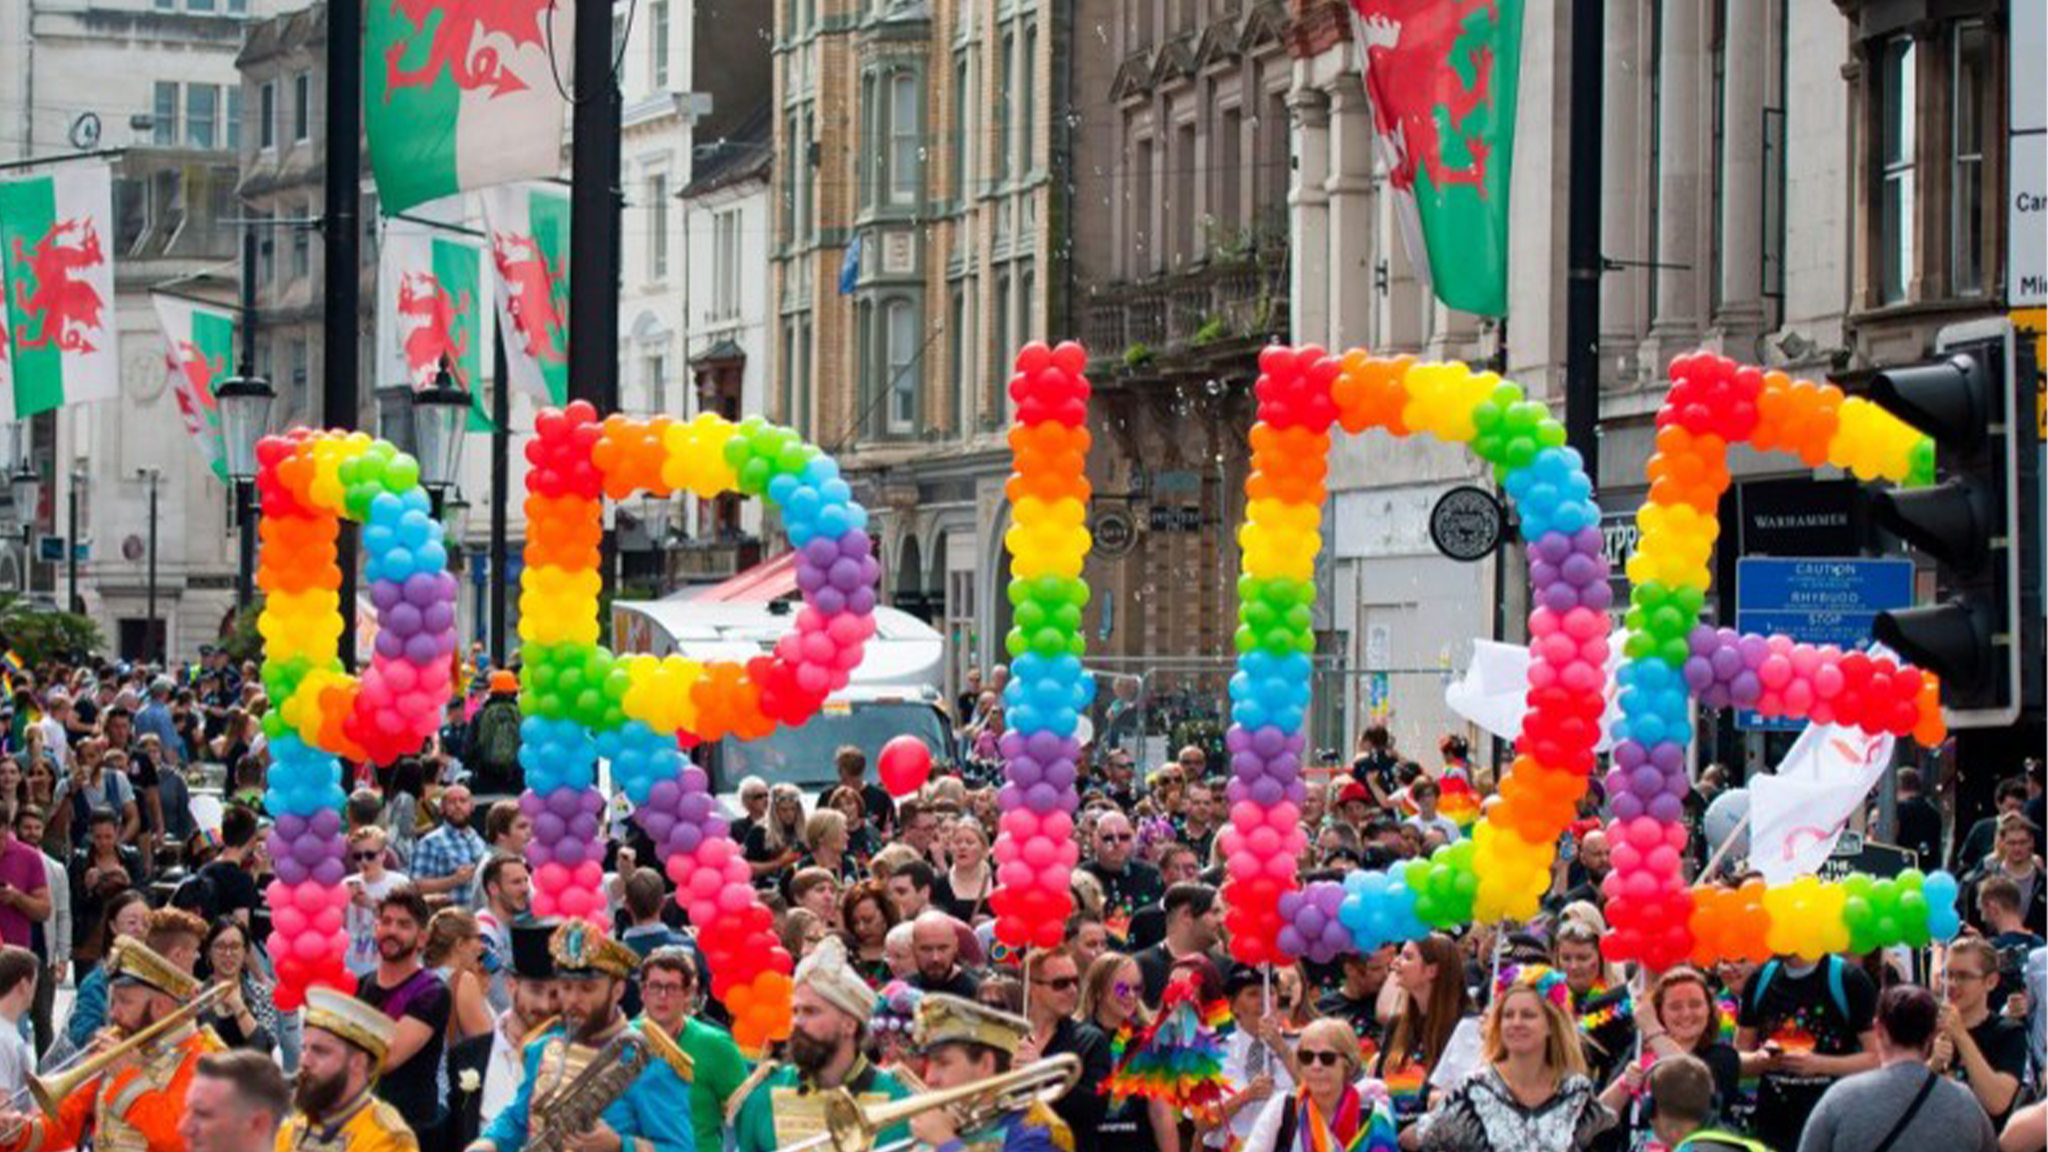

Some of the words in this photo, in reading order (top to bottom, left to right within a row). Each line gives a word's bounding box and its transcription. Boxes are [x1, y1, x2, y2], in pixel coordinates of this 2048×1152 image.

[1753, 513, 1847, 529] WARHAMMER
[1795, 564, 1856, 576] CAUTION
[1808, 613, 1842, 626] STOP
[254, 341, 1958, 1046] PRIDE
